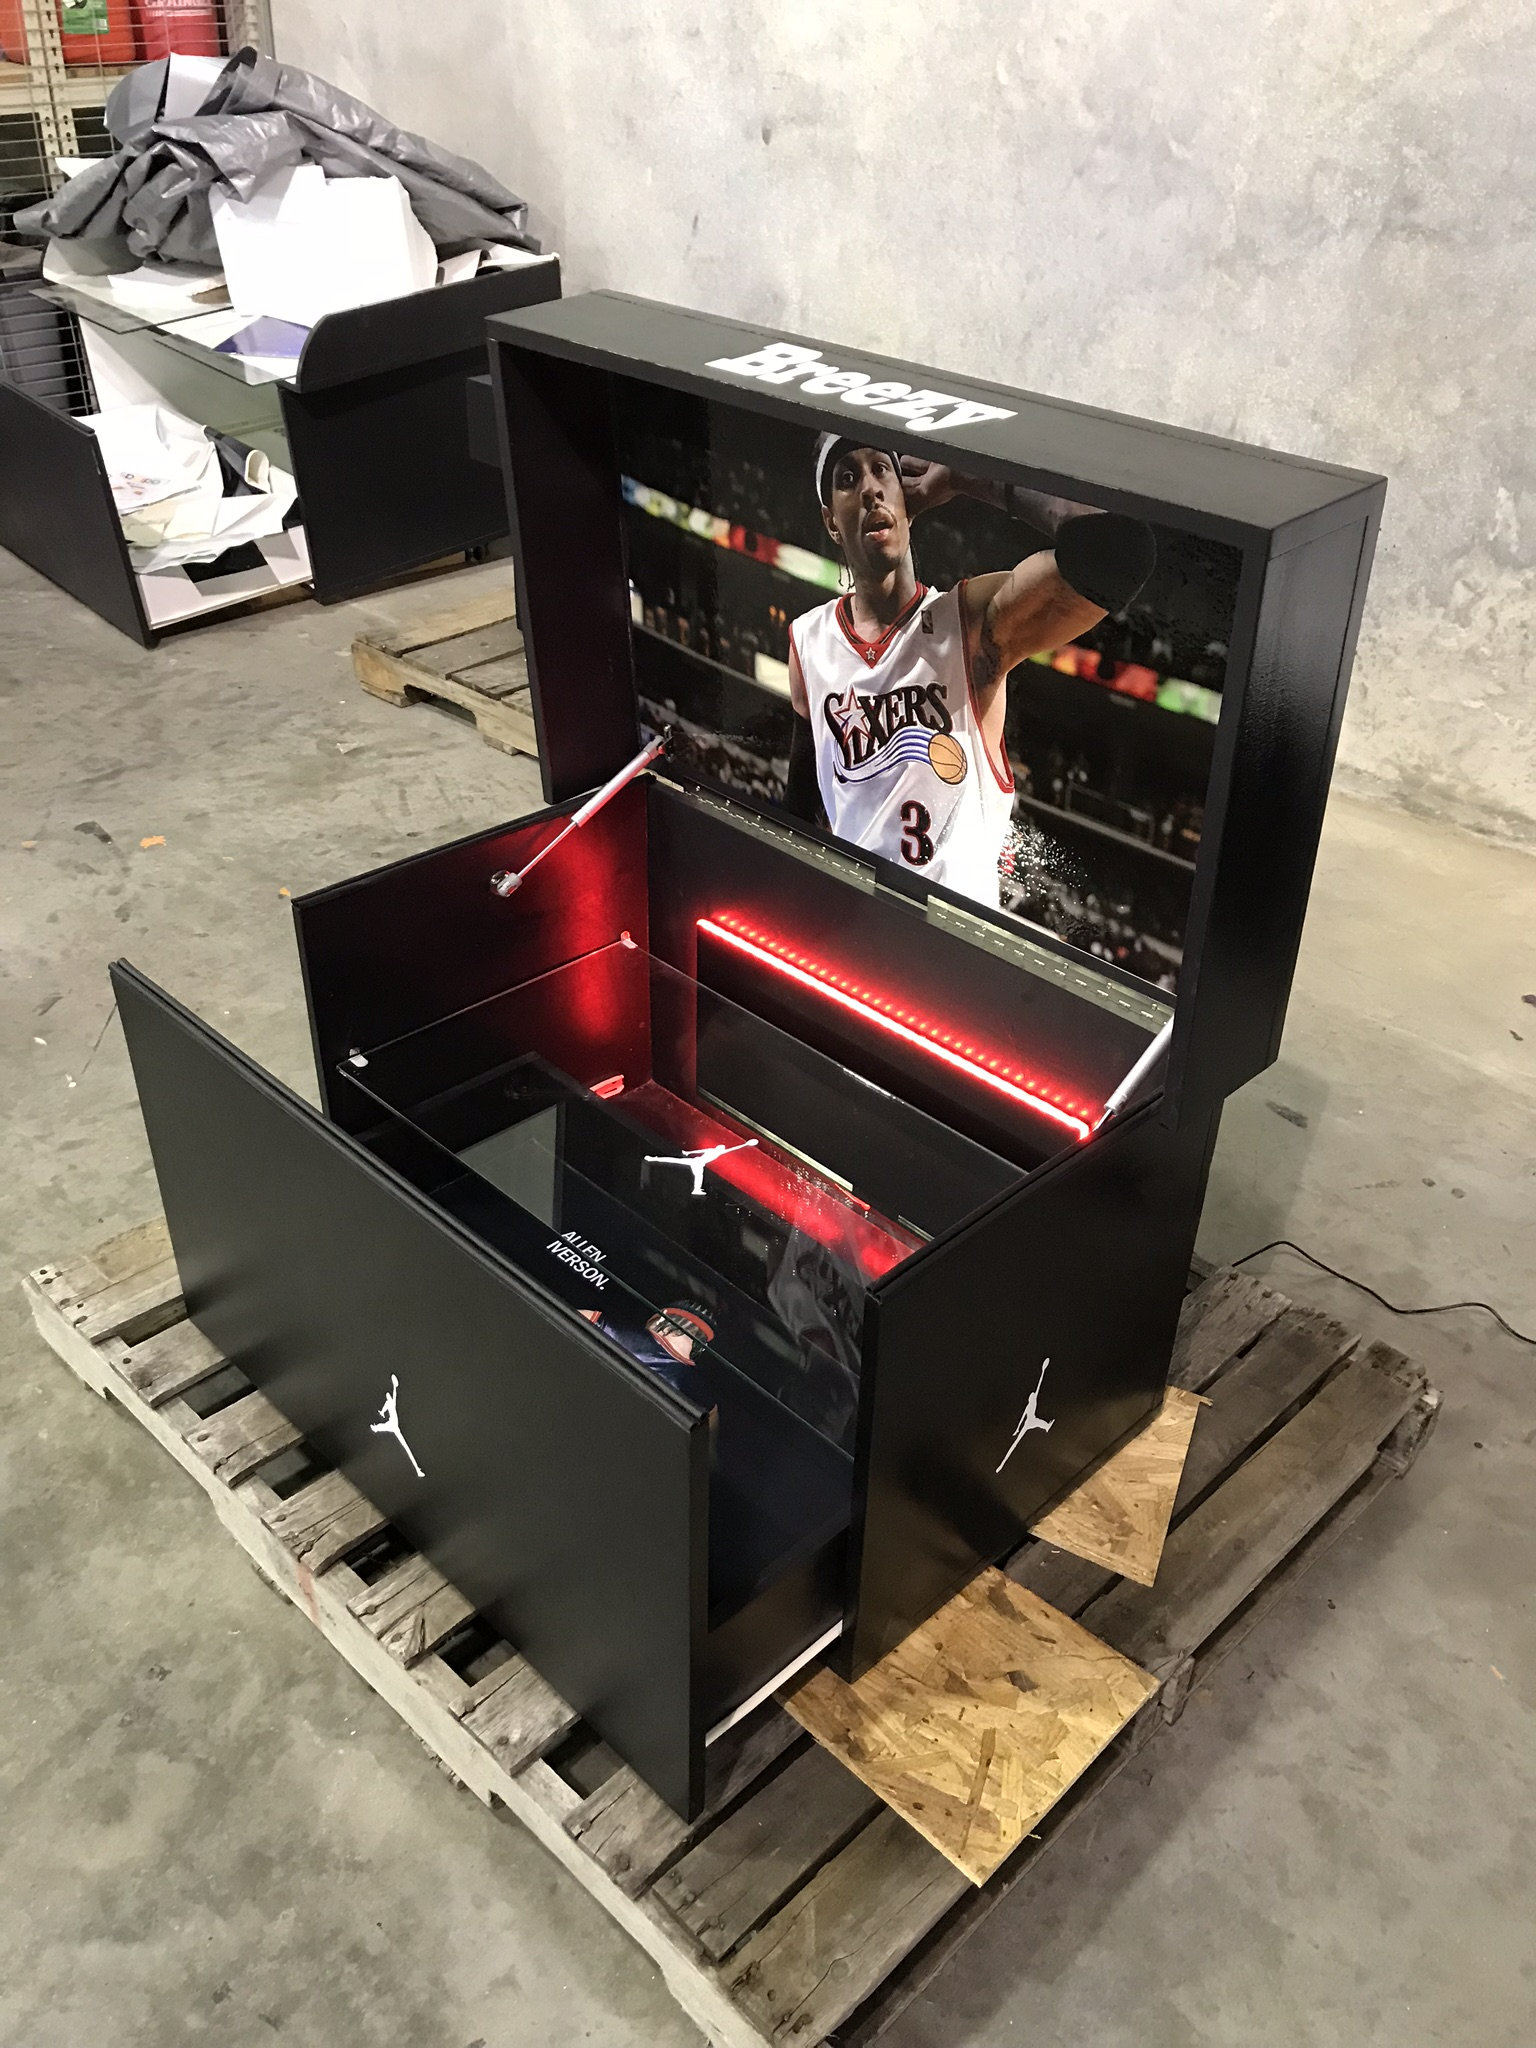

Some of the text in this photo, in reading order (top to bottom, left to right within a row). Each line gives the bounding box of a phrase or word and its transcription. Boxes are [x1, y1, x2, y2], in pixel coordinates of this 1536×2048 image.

[704, 342, 1018, 431] Breezy
[901, 800, 934, 866] 3
[546, 1240, 610, 1291] IVERSON.
[561, 1231, 607, 1263] ALLEN
